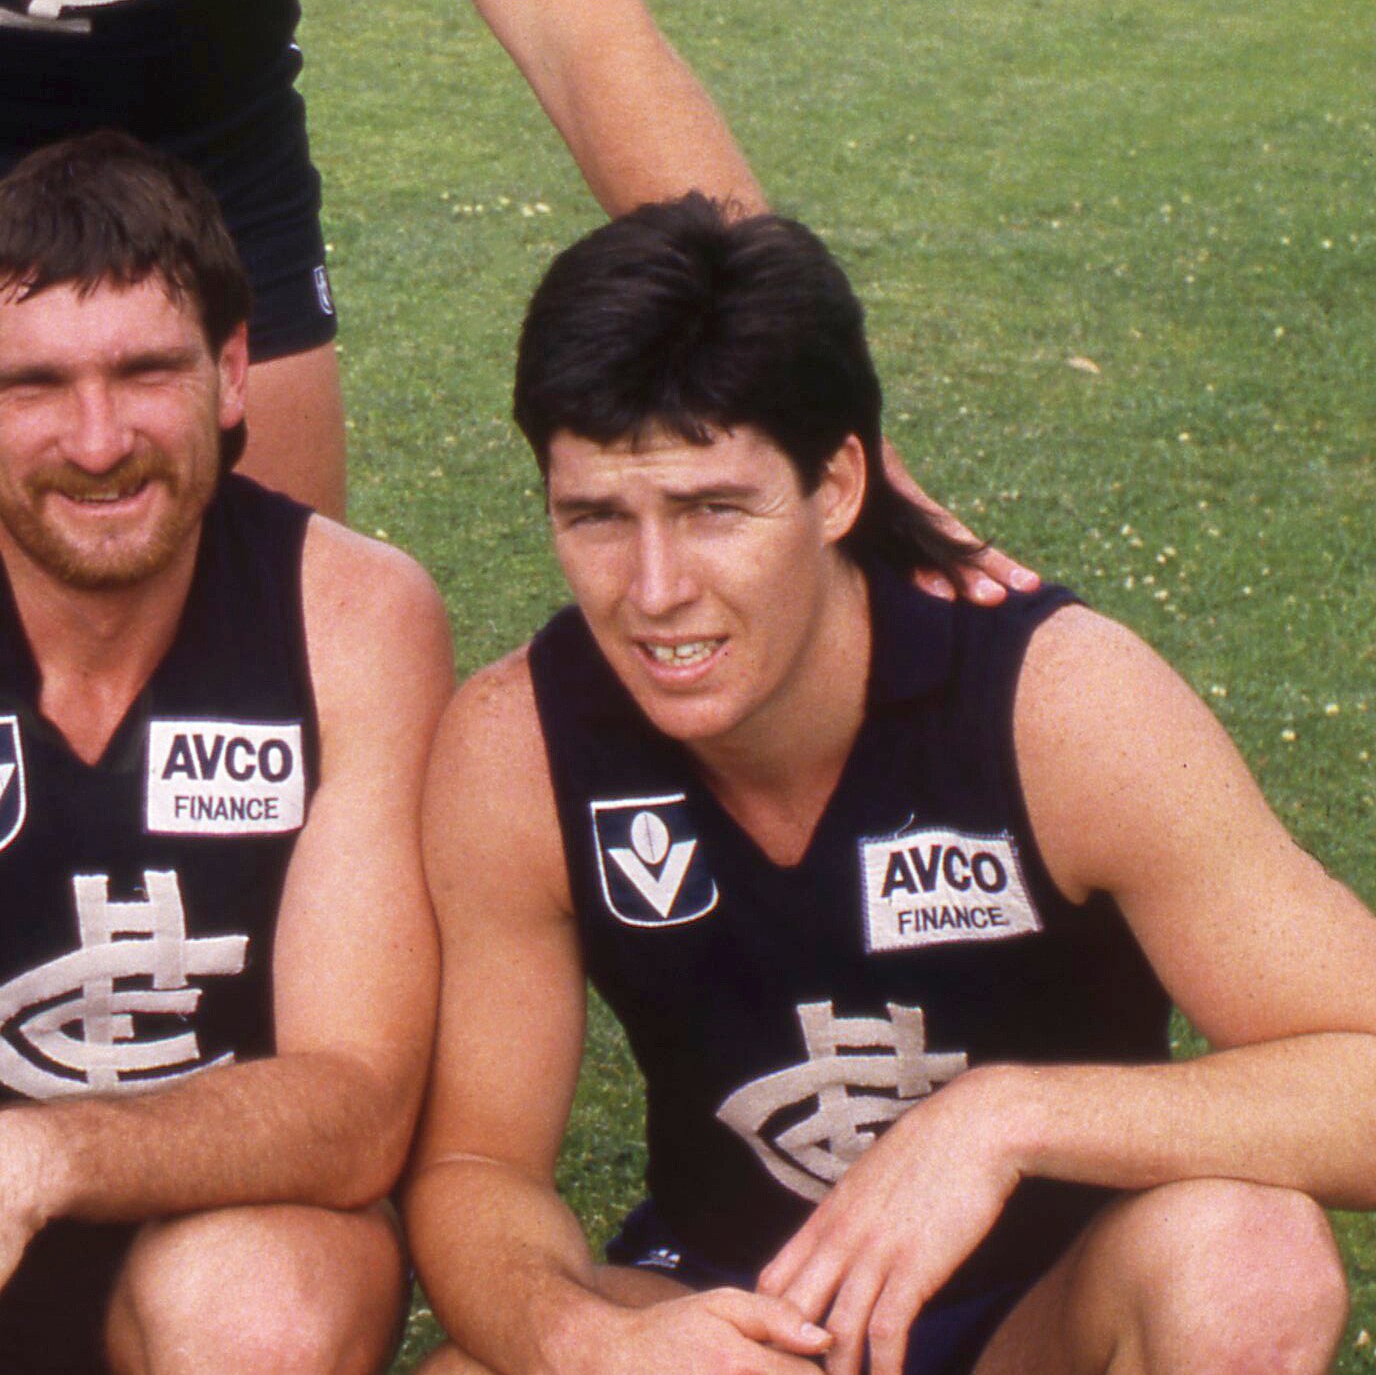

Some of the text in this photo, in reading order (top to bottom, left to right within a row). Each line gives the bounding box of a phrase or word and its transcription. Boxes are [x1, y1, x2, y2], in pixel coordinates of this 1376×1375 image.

[161, 734, 294, 783] AVCO
[174, 796, 279, 821] FINANCE
[881, 844, 1008, 899] AVCO
[897, 906, 1005, 935] FINANCE
